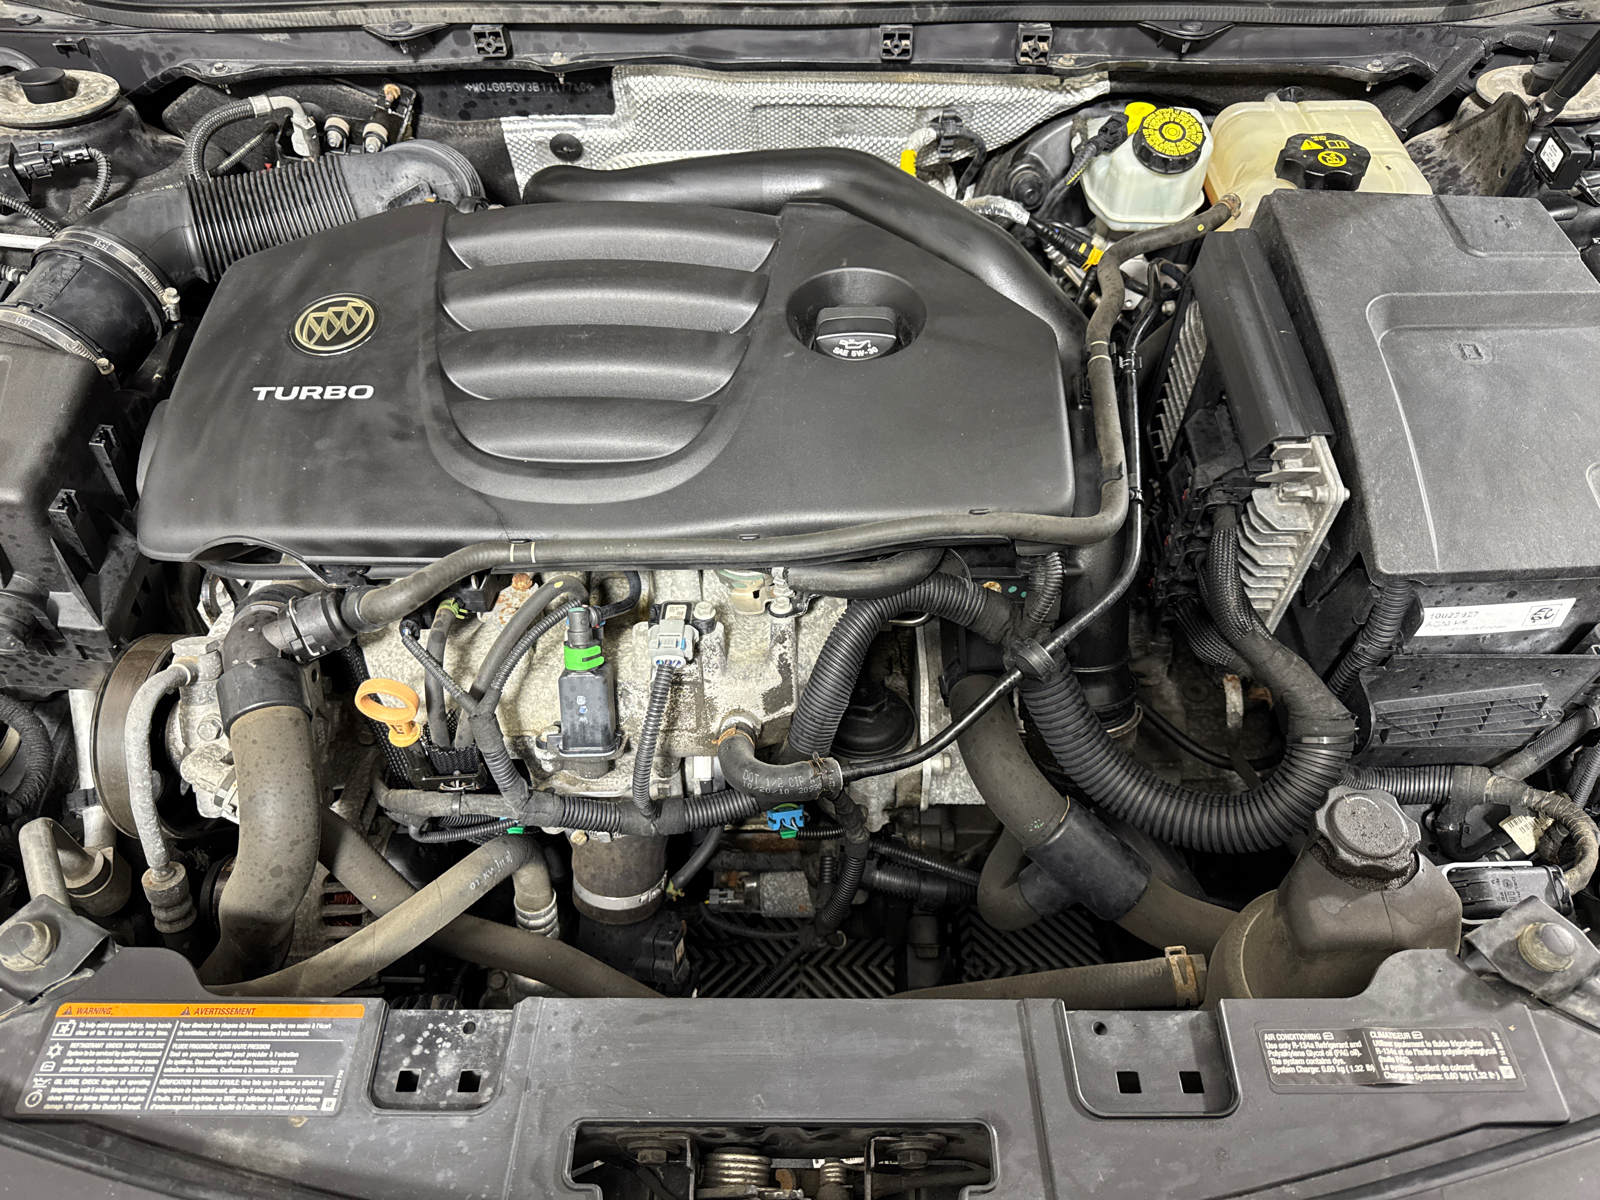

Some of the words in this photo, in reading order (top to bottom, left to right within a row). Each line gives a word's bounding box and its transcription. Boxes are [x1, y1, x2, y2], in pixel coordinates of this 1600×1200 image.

[832, 346, 850, 356] SAE
[851, 346, 878, 357] 5W-30
[252, 384, 374, 400] TURBO
[766, 776, 784, 788] 1/2
[76, 1007, 112, 1015] WARNING
[194, 1008, 257, 1016] AVERTISSEMENT
